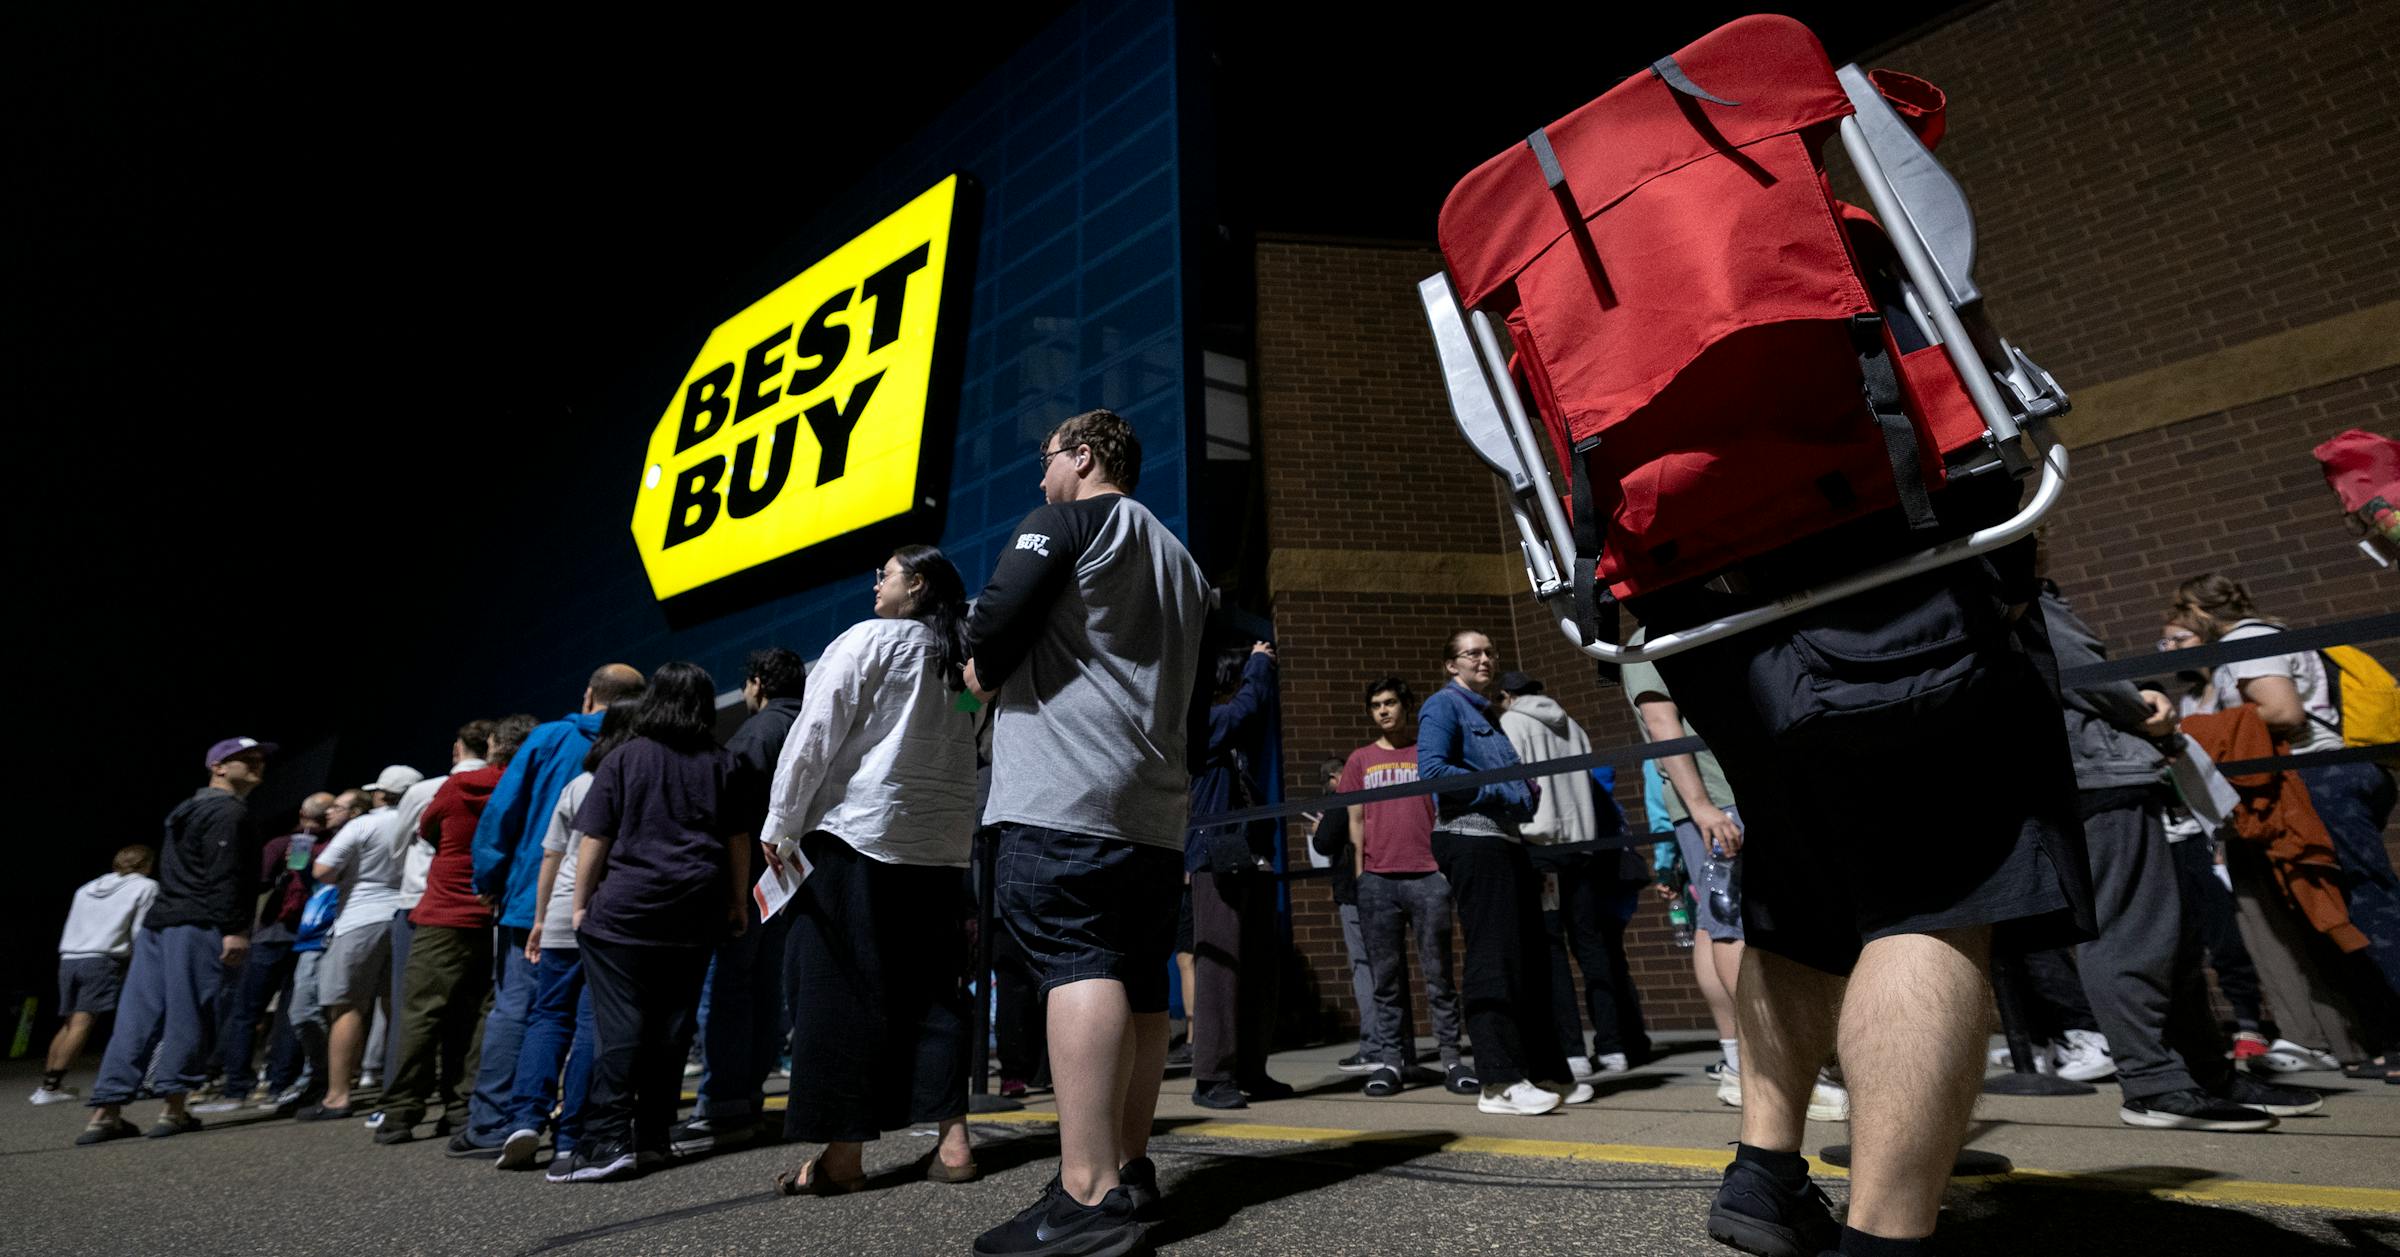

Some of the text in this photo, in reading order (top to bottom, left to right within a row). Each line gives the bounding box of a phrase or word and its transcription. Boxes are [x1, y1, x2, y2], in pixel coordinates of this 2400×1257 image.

[673, 239, 931, 457] BEST
[662, 368, 887, 551] BUY
[1015, 540, 1044, 551] BUY
[1018, 534, 1050, 544] BEST
